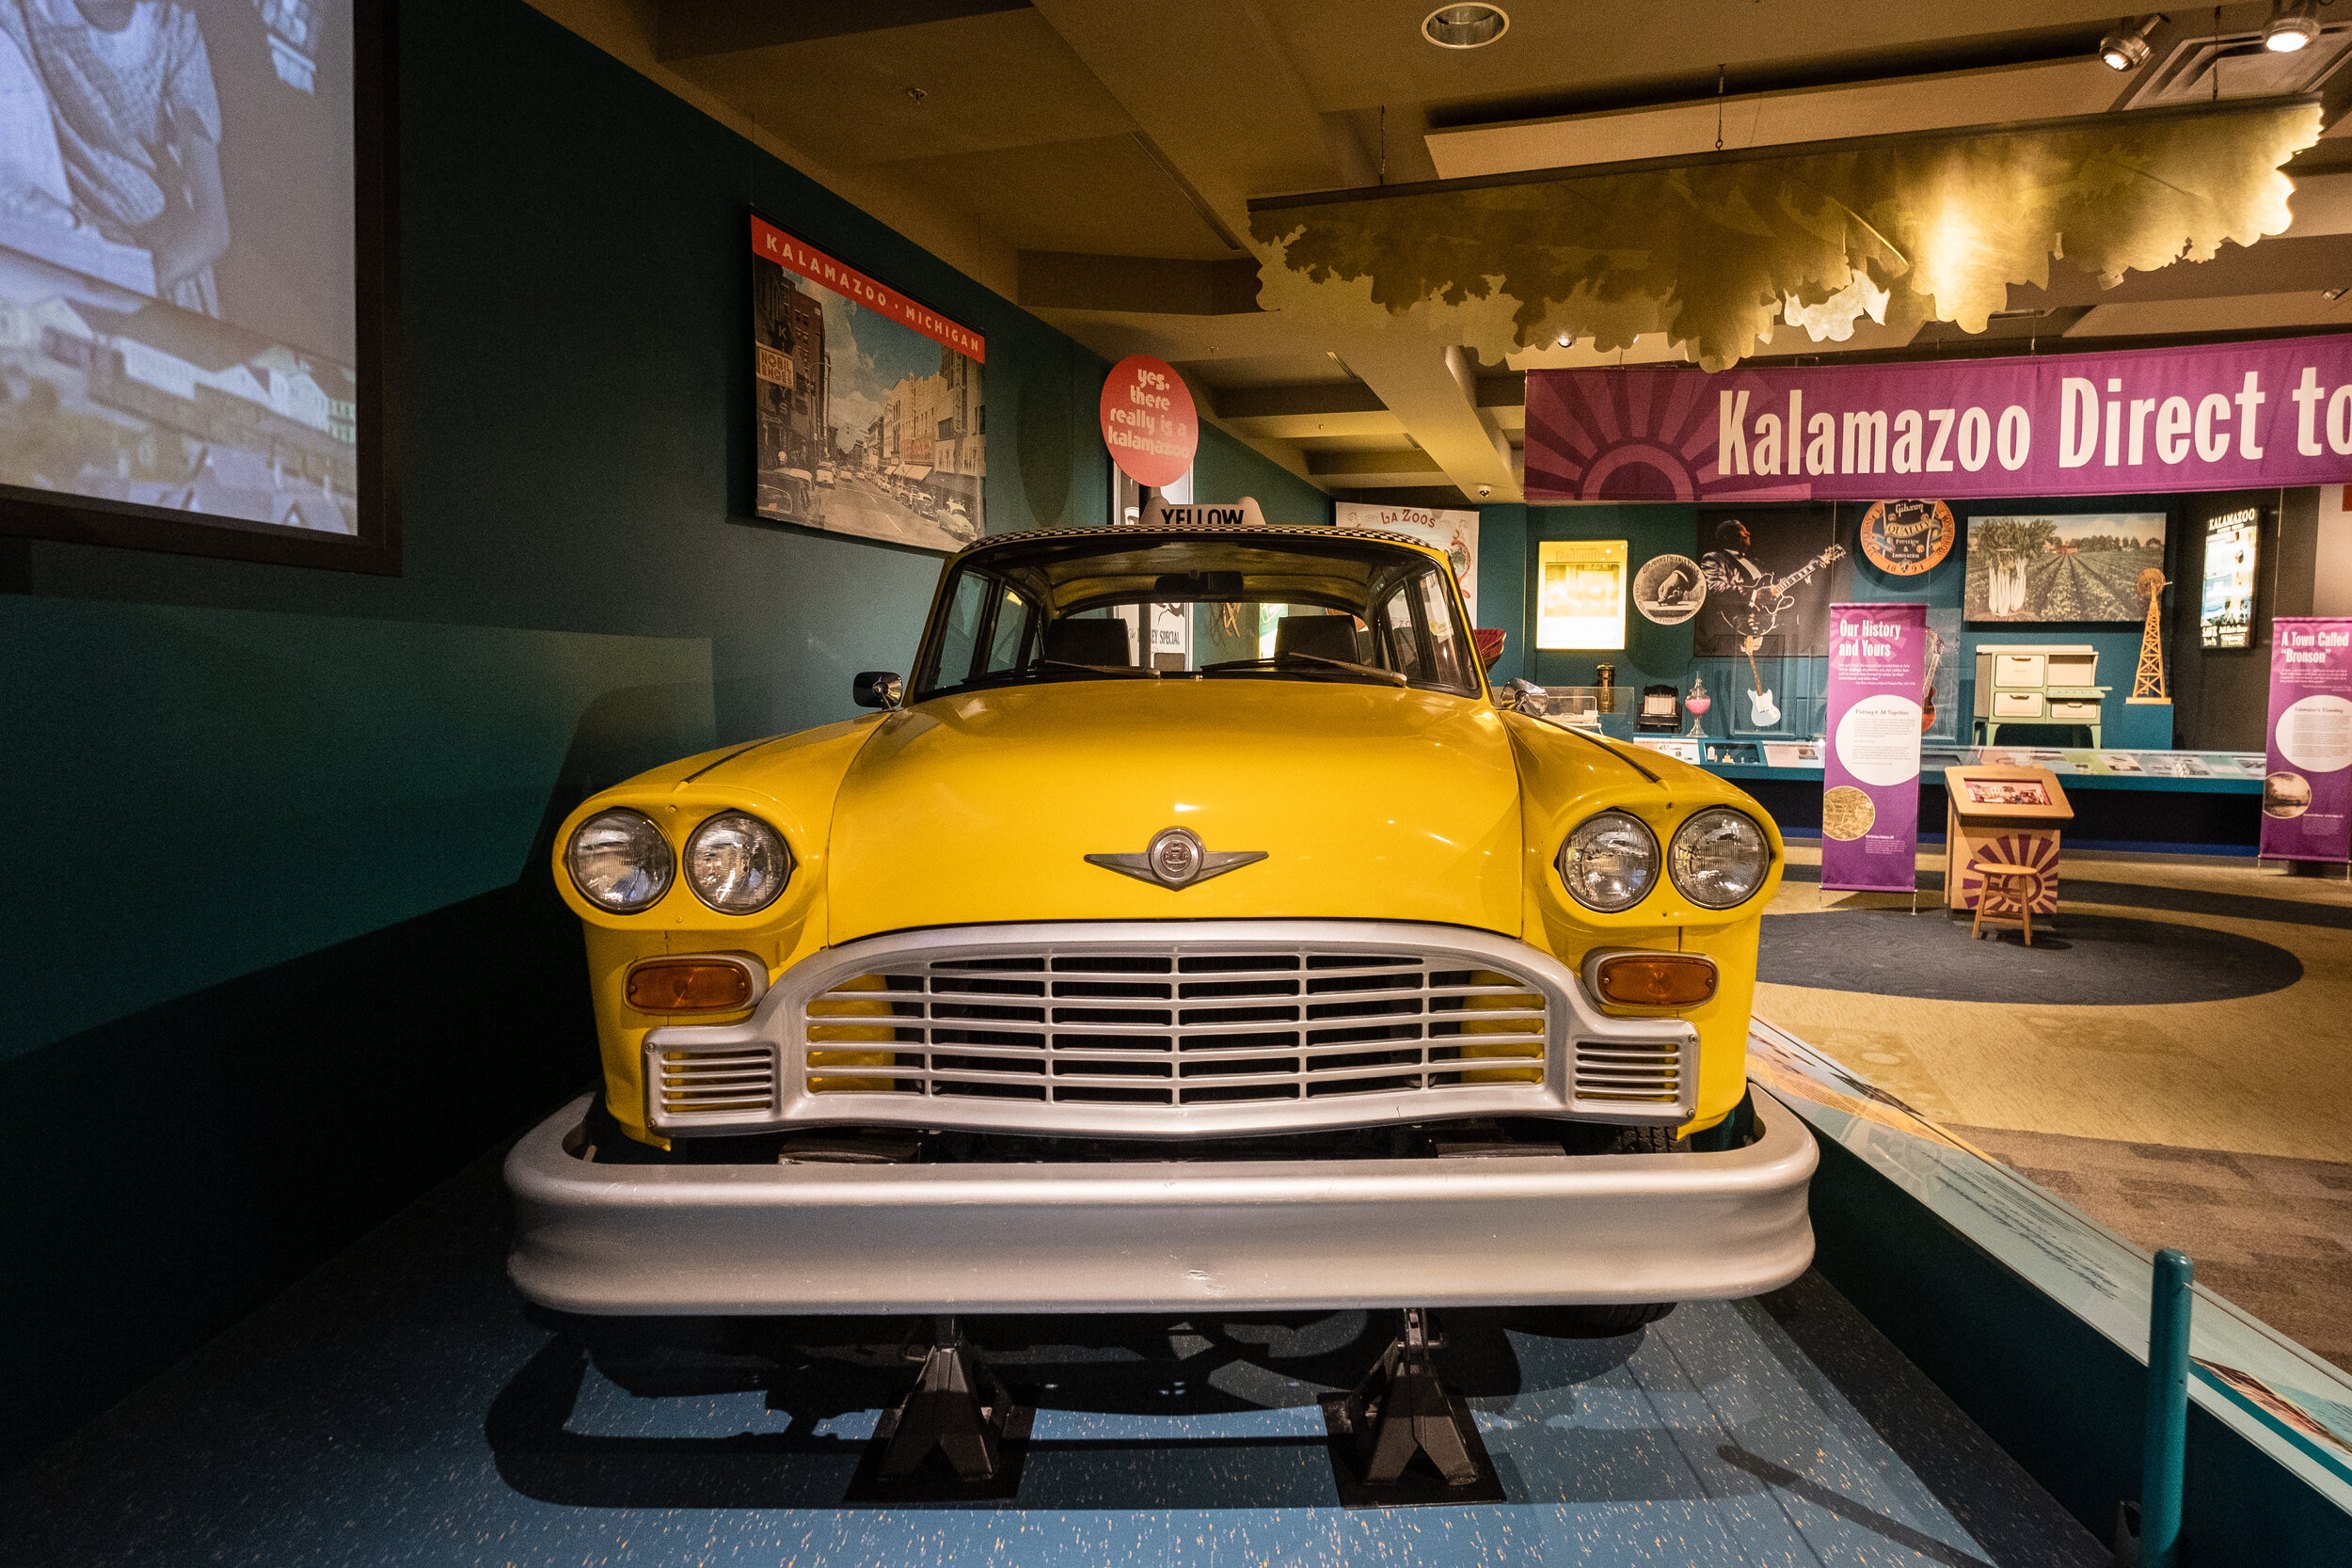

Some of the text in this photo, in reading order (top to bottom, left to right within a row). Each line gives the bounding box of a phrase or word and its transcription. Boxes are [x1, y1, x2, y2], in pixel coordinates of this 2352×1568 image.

[766, 232, 979, 354] KALAMAZOO MICHIGAN
[1130, 384, 1170, 412] there
[1110, 407, 1187, 437] really is a
[1718, 366, 2352, 475] Kalamazoo Direct to
[1161, 509, 1245, 524] YELLOW
[1895, 502, 1924, 517] Gibson
[2208, 507, 2256, 531] KALAMAZOO
[1887, 520, 1930, 536] QUALITY
[1159, 630, 1180, 645] SPECIAL
[1839, 620, 1901, 641] Our History
[2280, 631, 2349, 647] A Town Called
[1838, 639, 1892, 657] and Yours
